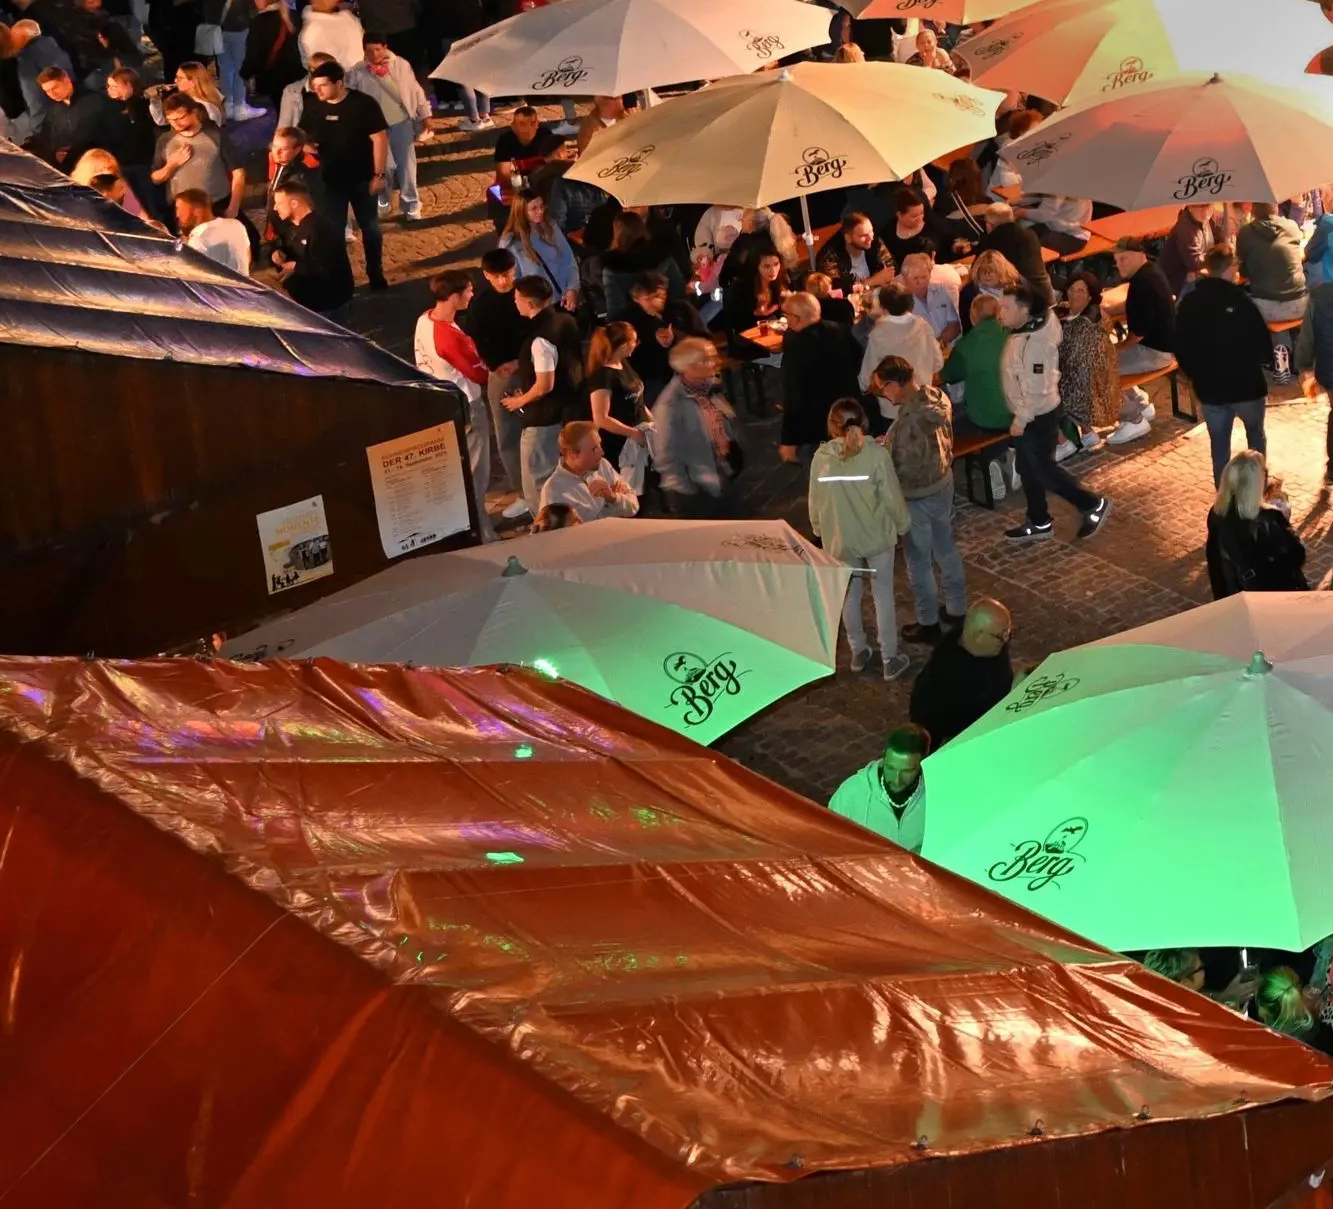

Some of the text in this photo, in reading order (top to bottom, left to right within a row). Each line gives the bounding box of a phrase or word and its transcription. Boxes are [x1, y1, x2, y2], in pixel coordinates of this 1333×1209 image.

[532, 67, 589, 92] Berg
[1101, 68, 1155, 93] Berg
[598, 156, 644, 182] Berg
[796, 158, 848, 188] Berg
[1173, 173, 1233, 200] Berg
[382, 456, 402, 468] DER
[418, 442, 446, 457] KIRBE
[669, 659, 742, 727] Berg
[988, 840, 1076, 892] Berg
